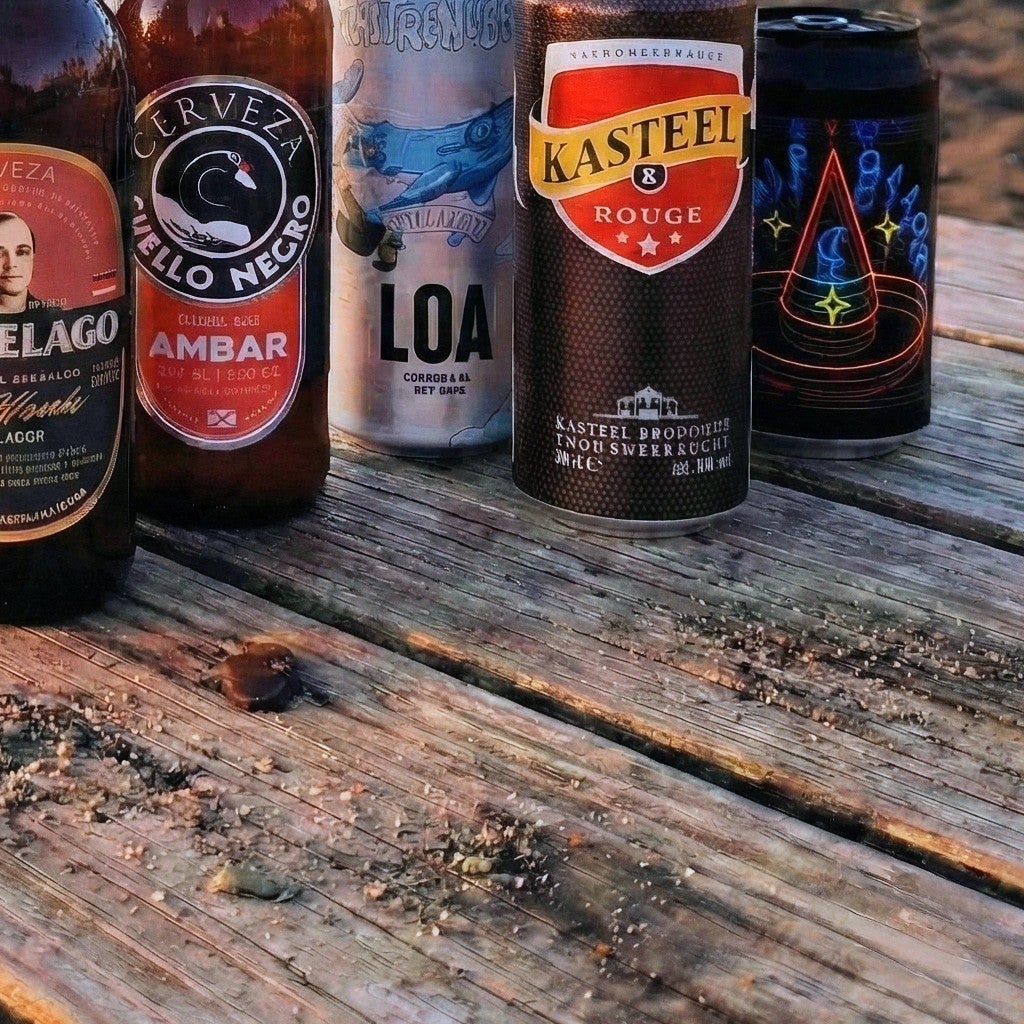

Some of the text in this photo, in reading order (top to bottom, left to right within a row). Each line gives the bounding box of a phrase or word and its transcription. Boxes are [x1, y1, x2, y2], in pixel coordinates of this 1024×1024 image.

[133, 92, 303, 163] CERVEZA
[542, 105, 736, 184] KASTEEL
[640, 167, 658, 186] 8
[230, 194, 311, 292] NEGRO
[594, 206, 702, 225] ROUGE
[149, 332, 288, 362] AMBAR
[380, 283, 494, 364] LOA
